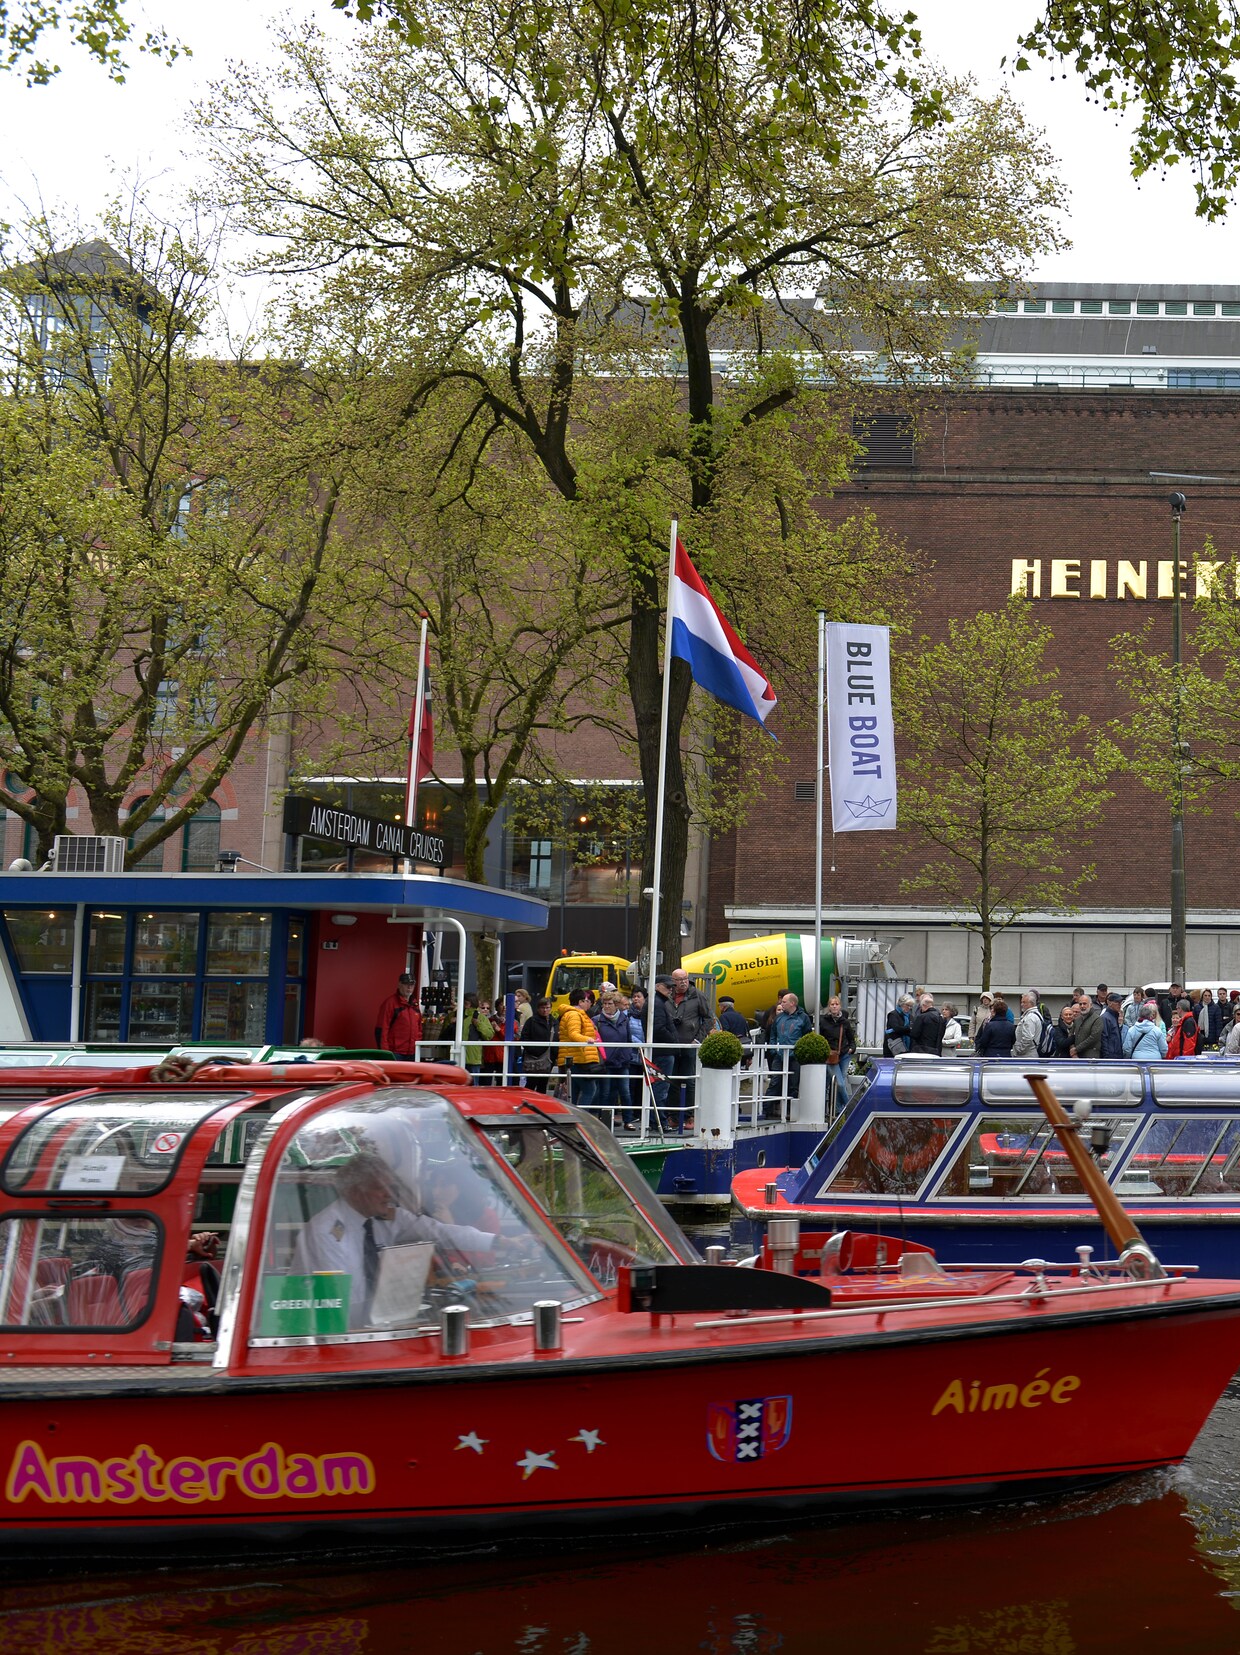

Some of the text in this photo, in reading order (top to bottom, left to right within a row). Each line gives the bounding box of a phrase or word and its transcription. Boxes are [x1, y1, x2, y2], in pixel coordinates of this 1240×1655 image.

[846, 641, 882, 779] BLUE BOAT
[309, 806, 444, 863] AMSTERDAM CANAL CRUISES
[735, 956, 779, 971] mebin
[270, 1299, 343, 1310] GREEN LINE
[931, 1367, 1082, 1416] Aimée
[6, 1440, 375, 1503] Amsterdam
